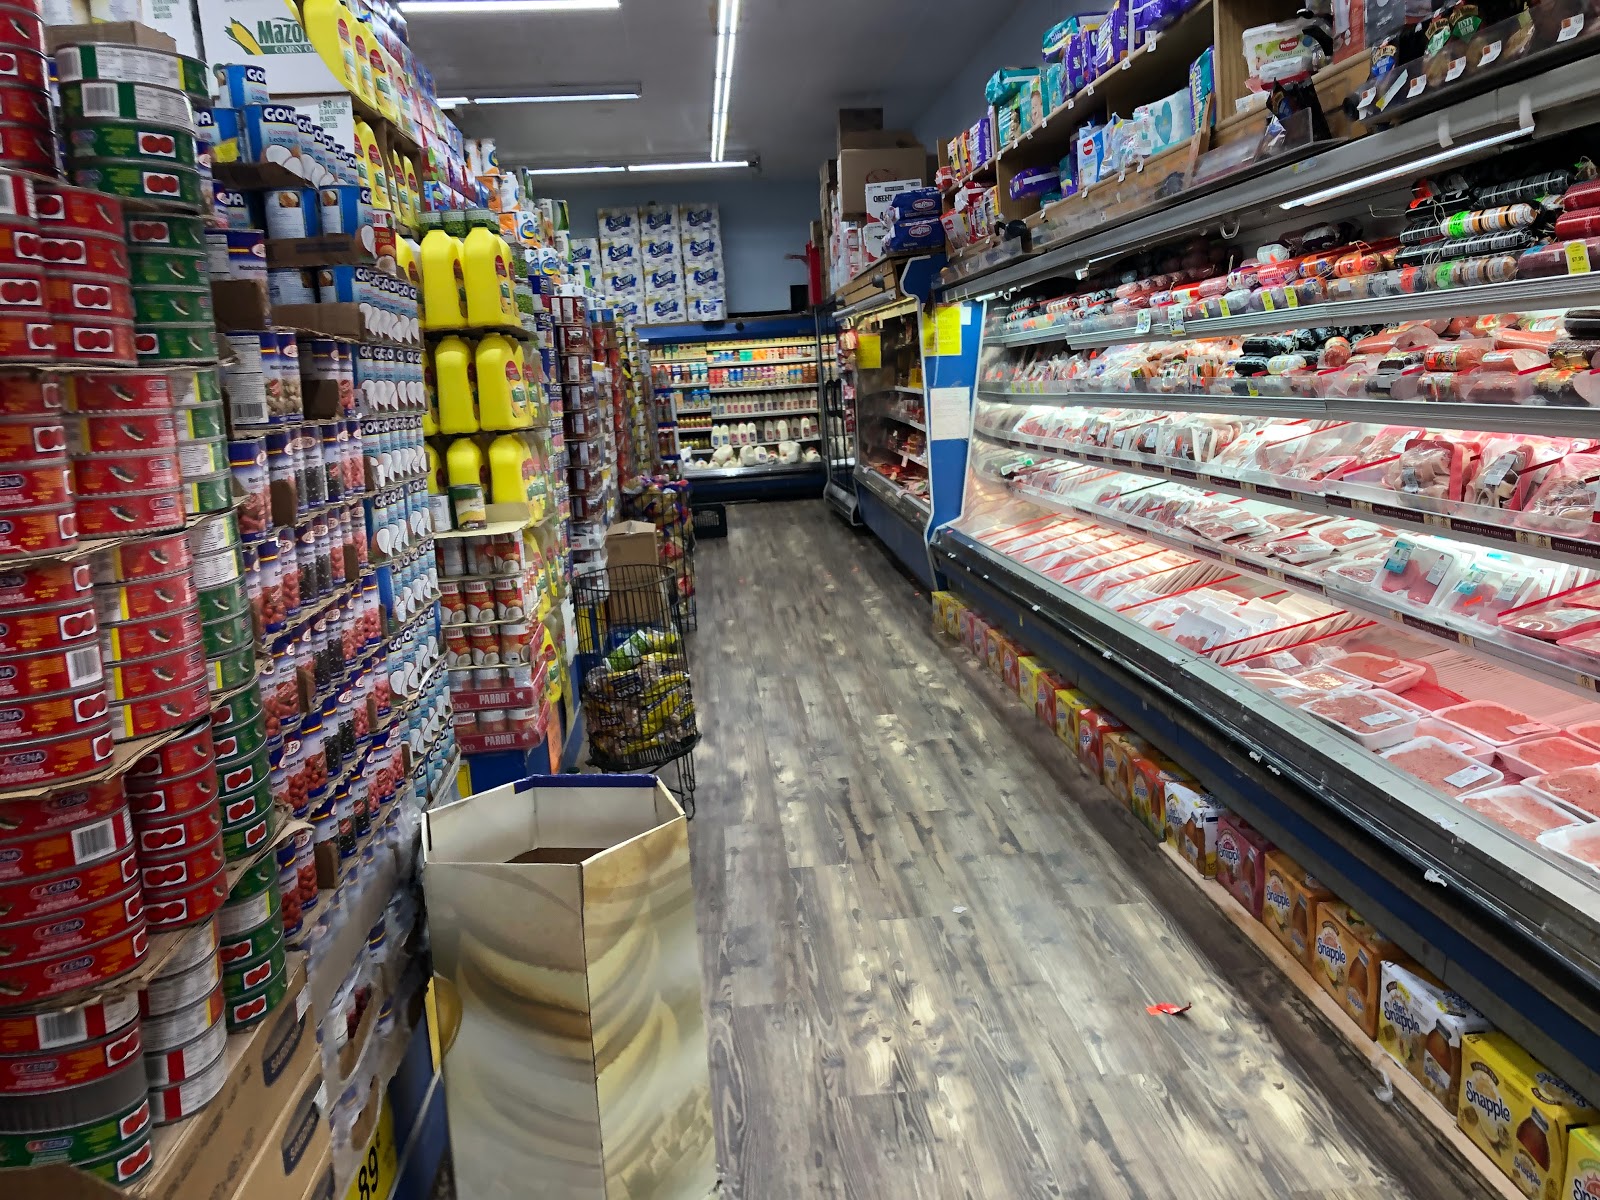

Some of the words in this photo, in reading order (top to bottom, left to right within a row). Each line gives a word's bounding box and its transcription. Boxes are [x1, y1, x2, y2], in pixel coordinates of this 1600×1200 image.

[257, 21, 309, 43] Mazo
[1274, 51, 1292, 59] natural
[247, 69, 266, 81] GO
[264, 108, 297, 122] GOY
[479, 693, 510, 704] PARROT
[485, 734, 515, 746] PARROT
[1266, 886, 1290, 909] Snapple
[1318, 938, 1346, 965] Snapple
[1384, 1001, 1420, 1034] Snapple
[1392, 1001, 1406, 1016] diet
[1466, 1080, 1511, 1122] Snapple
[1514, 1156, 1541, 1187] Snapple
